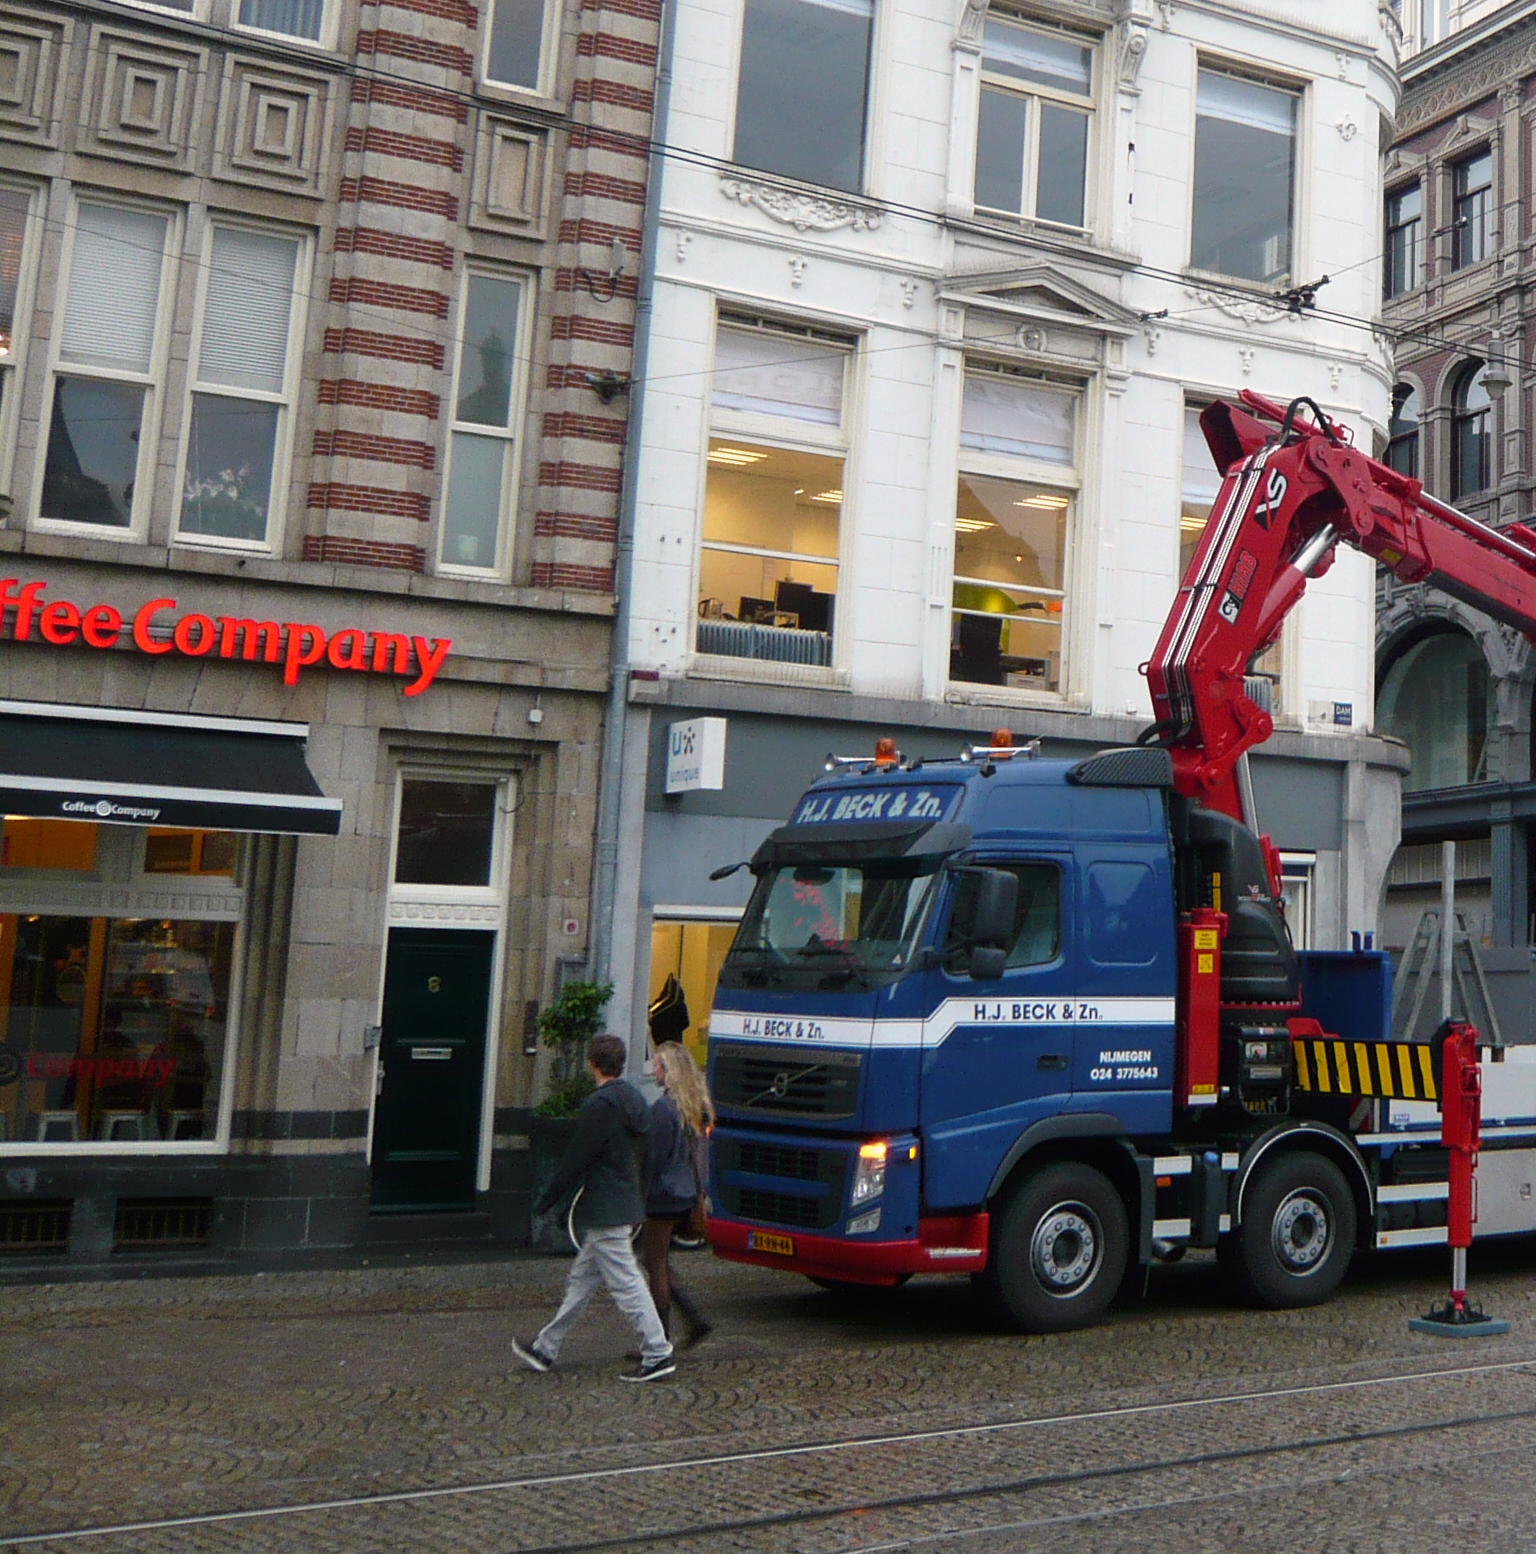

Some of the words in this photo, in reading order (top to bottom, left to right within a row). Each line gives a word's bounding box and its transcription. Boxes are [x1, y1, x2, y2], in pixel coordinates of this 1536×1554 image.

[1227, 550, 1259, 600] HIAB
[133, 598, 452, 697] Company
[62, 801, 97, 813] Coffee
[111, 804, 161, 821] Company
[796, 798, 832, 825] H.J.
[831, 793, 891, 821] BECK
[887, 791, 908, 818] &
[908, 791, 944, 818] Zn.
[974, 1003, 1007, 1021] H.J.
[1012, 1003, 1057, 1020] BECK
[1062, 1003, 1074, 1020] &
[1079, 1003, 1103, 1020] Zn.
[742, 1018, 761, 1036] H.J.
[764, 1019, 793, 1037] BECK
[795, 1021, 804, 1038] &
[807, 1022, 825, 1040] Zn.
[1100, 1050, 1152, 1064] NIJMEGEN
[26, 1052, 177, 1089] Company
[1090, 1067, 1113, 1081] 024
[1116, 1066, 1159, 1080] 3775643
